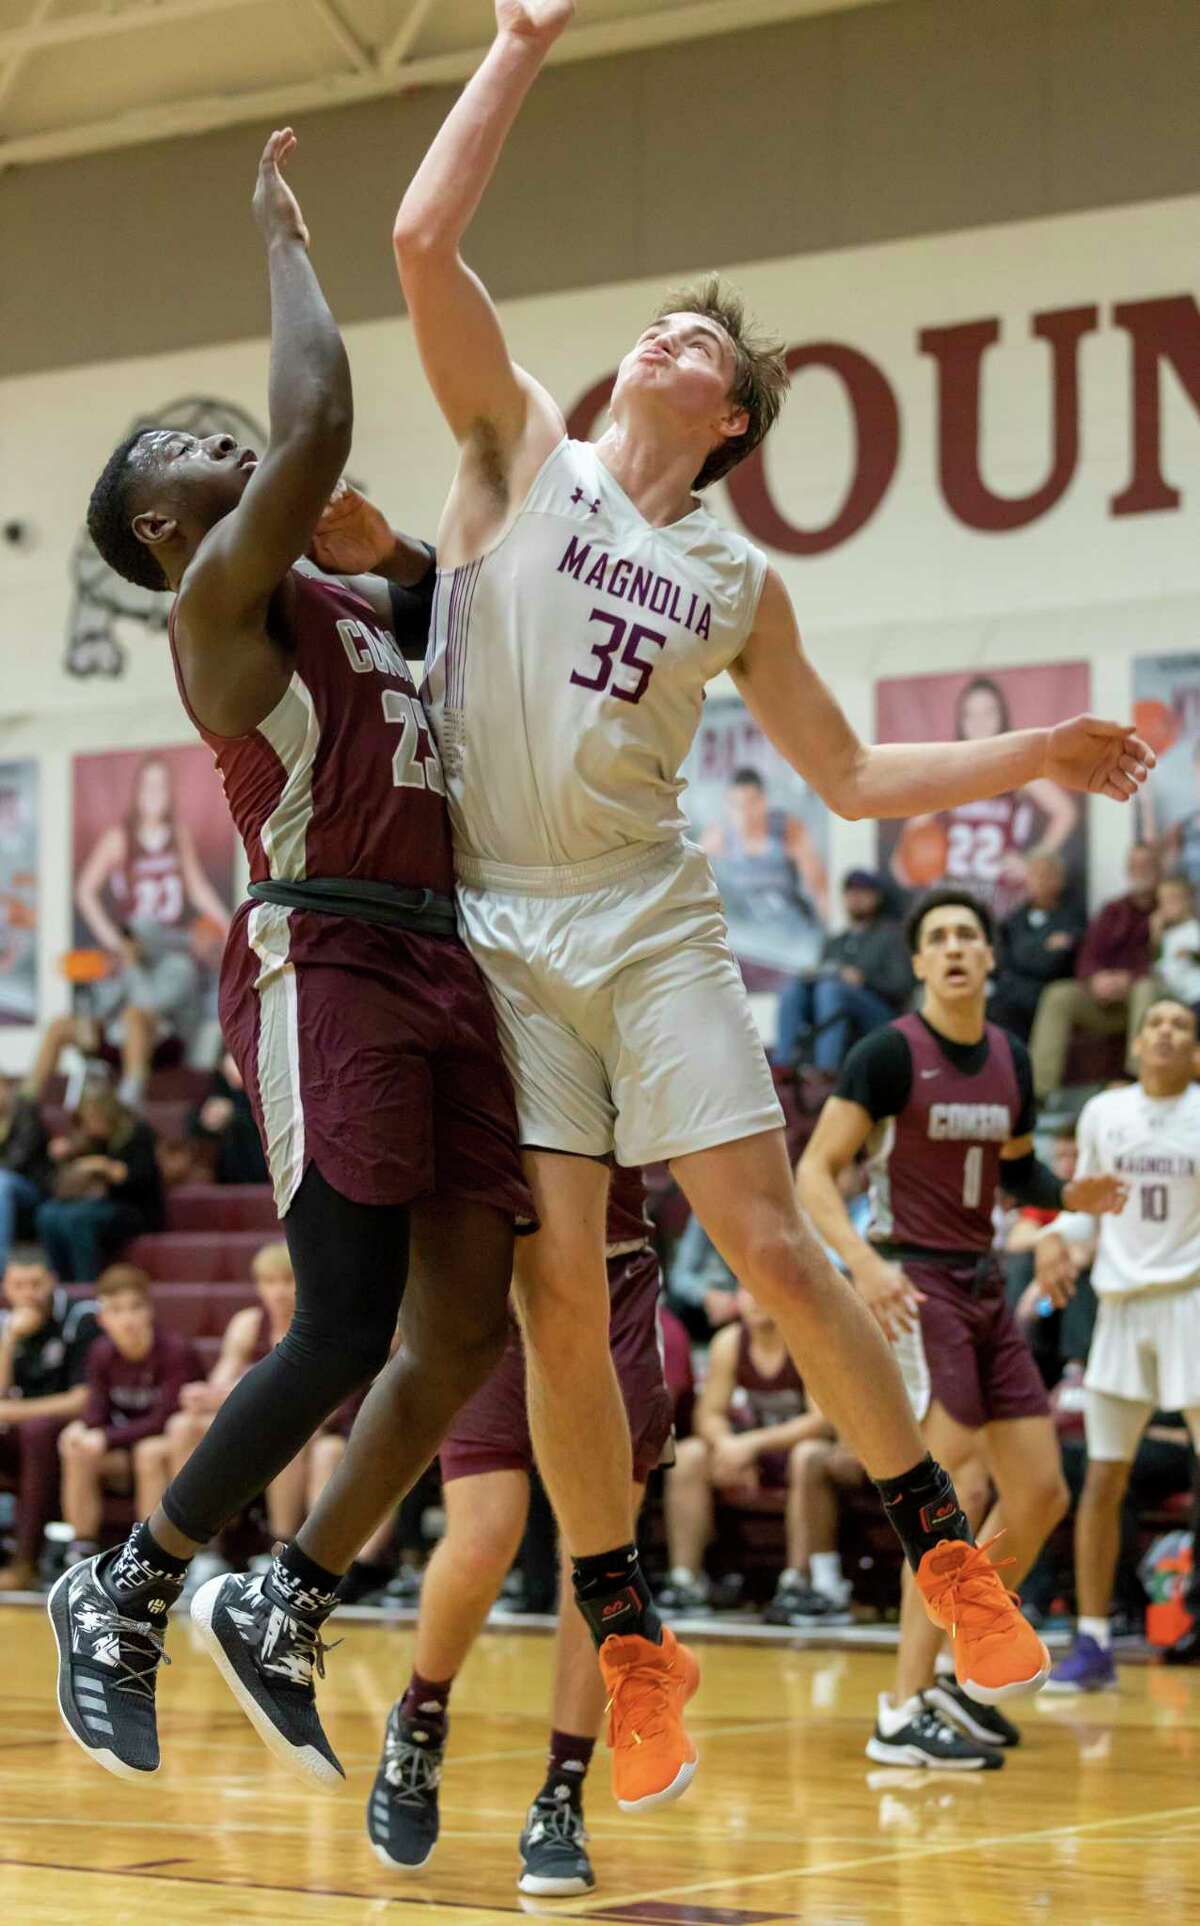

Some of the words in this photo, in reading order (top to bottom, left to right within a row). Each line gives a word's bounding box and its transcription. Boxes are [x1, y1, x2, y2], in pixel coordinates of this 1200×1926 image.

[566, 295, 1200, 557] OU
[557, 535, 712, 641] MAGNOLIA
[570, 608, 667, 705] 35
[947, 823, 1005, 879] 22
[962, 1146, 983, 1208] 1
[1141, 1183, 1168, 1221] 10
